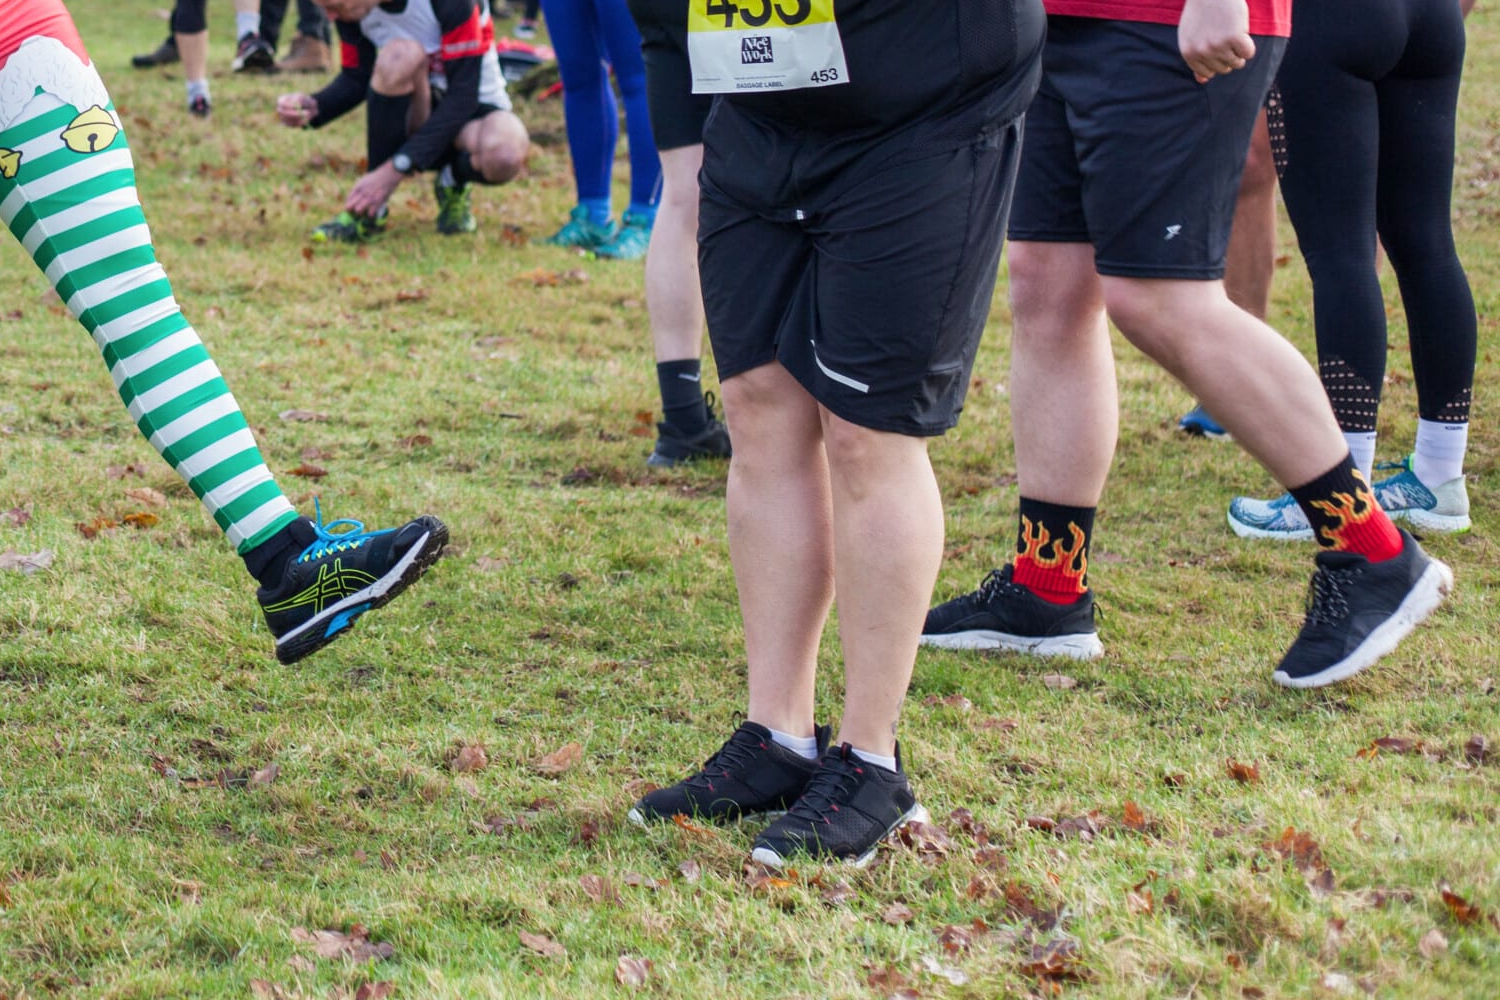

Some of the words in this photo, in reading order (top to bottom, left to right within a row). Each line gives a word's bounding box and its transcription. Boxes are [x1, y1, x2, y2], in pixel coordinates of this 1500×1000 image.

[745, 37, 769, 51] Nice
[742, 46, 773, 63] Work
[810, 68, 838, 83] 453
